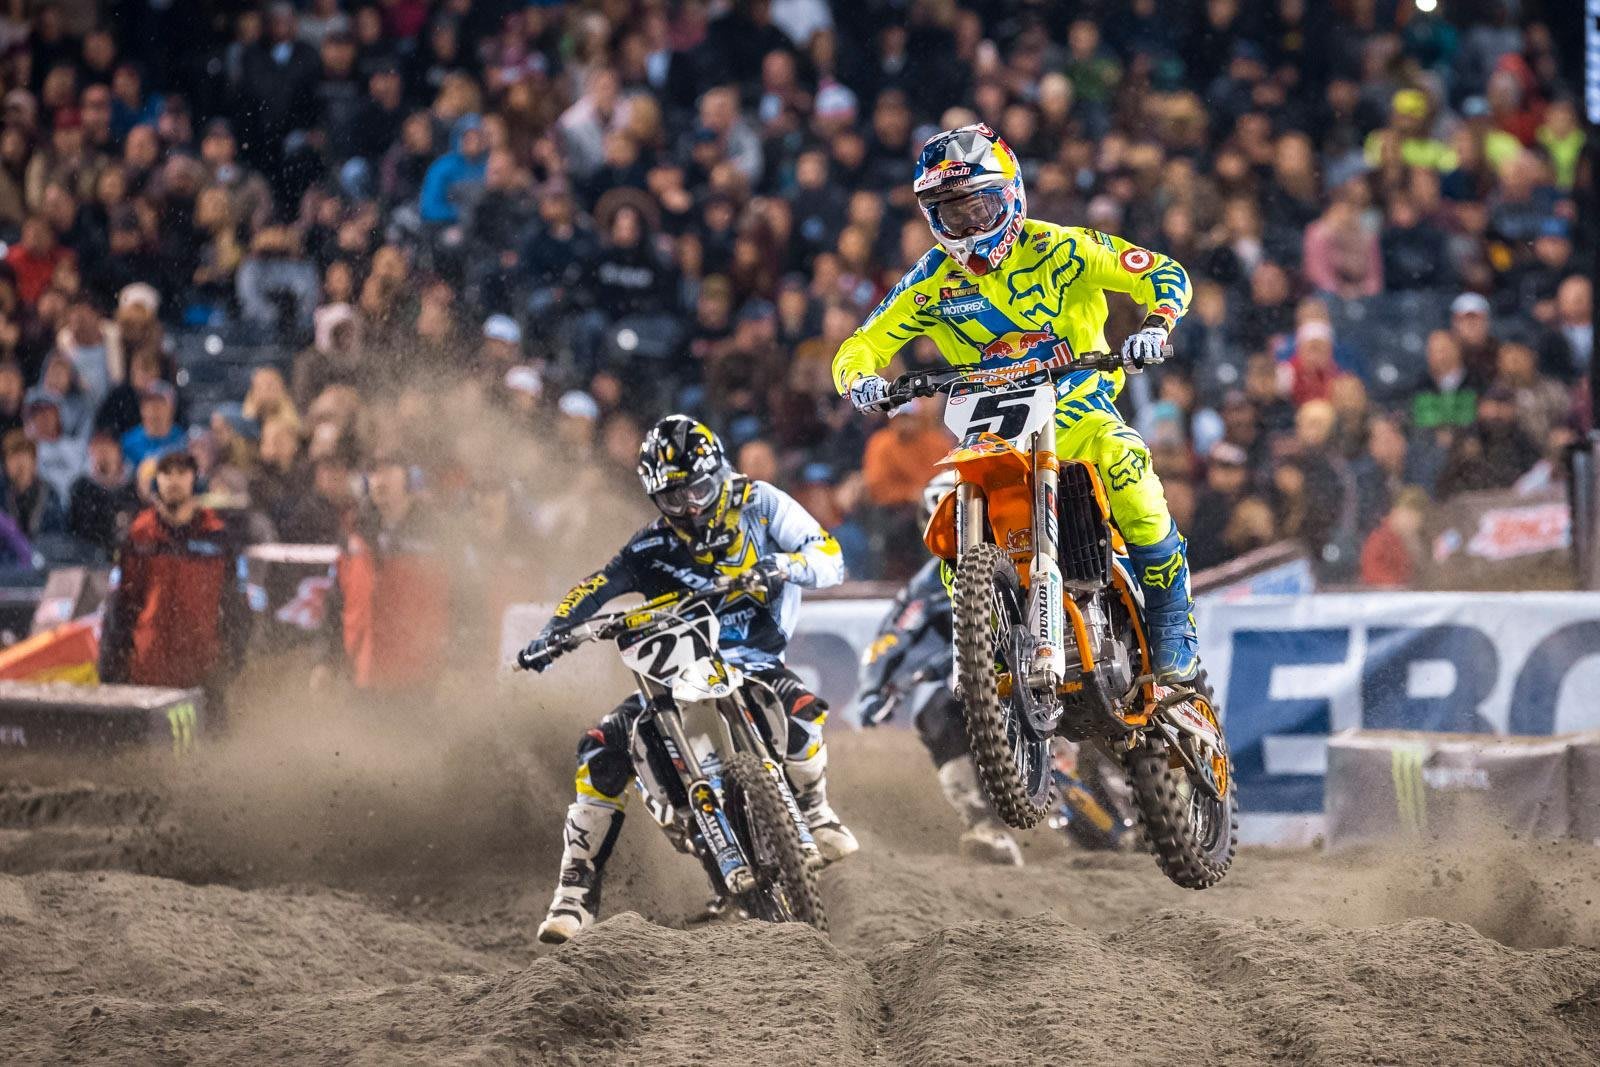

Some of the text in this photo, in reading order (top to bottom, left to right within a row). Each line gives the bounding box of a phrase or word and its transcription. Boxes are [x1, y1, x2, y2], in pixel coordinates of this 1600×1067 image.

[943, 167, 971, 179] Bull
[943, 301, 986, 315] MOTOREX
[964, 389, 1037, 440] 5
[1038, 582, 1049, 639] DUNLOP
[638, 619, 711, 680] 21
